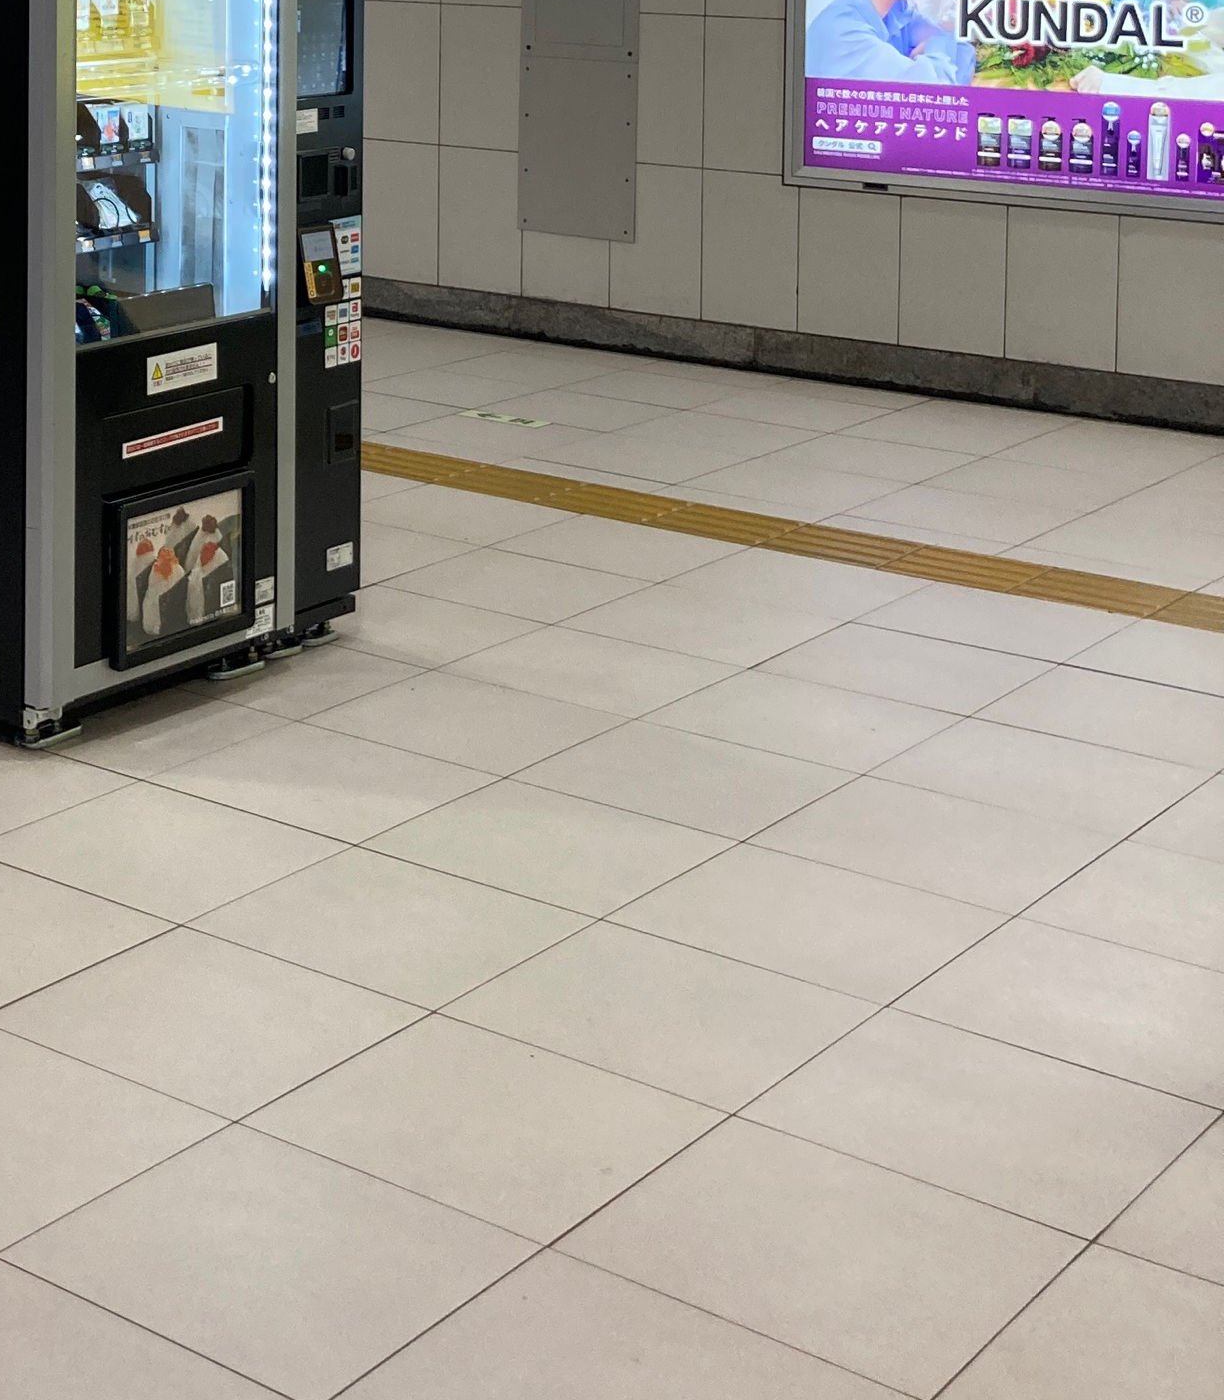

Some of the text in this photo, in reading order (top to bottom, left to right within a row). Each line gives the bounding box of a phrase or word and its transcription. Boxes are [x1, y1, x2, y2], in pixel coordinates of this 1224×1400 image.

[816, 88, 969, 106] 韓国で数々の賞を受賞し日本に上陸した
[816, 101, 969, 124] PREMIUM NATURE
[815, 119, 968, 141] ヘアケアブランド
[818, 140, 864, 150] クンダル 公式
